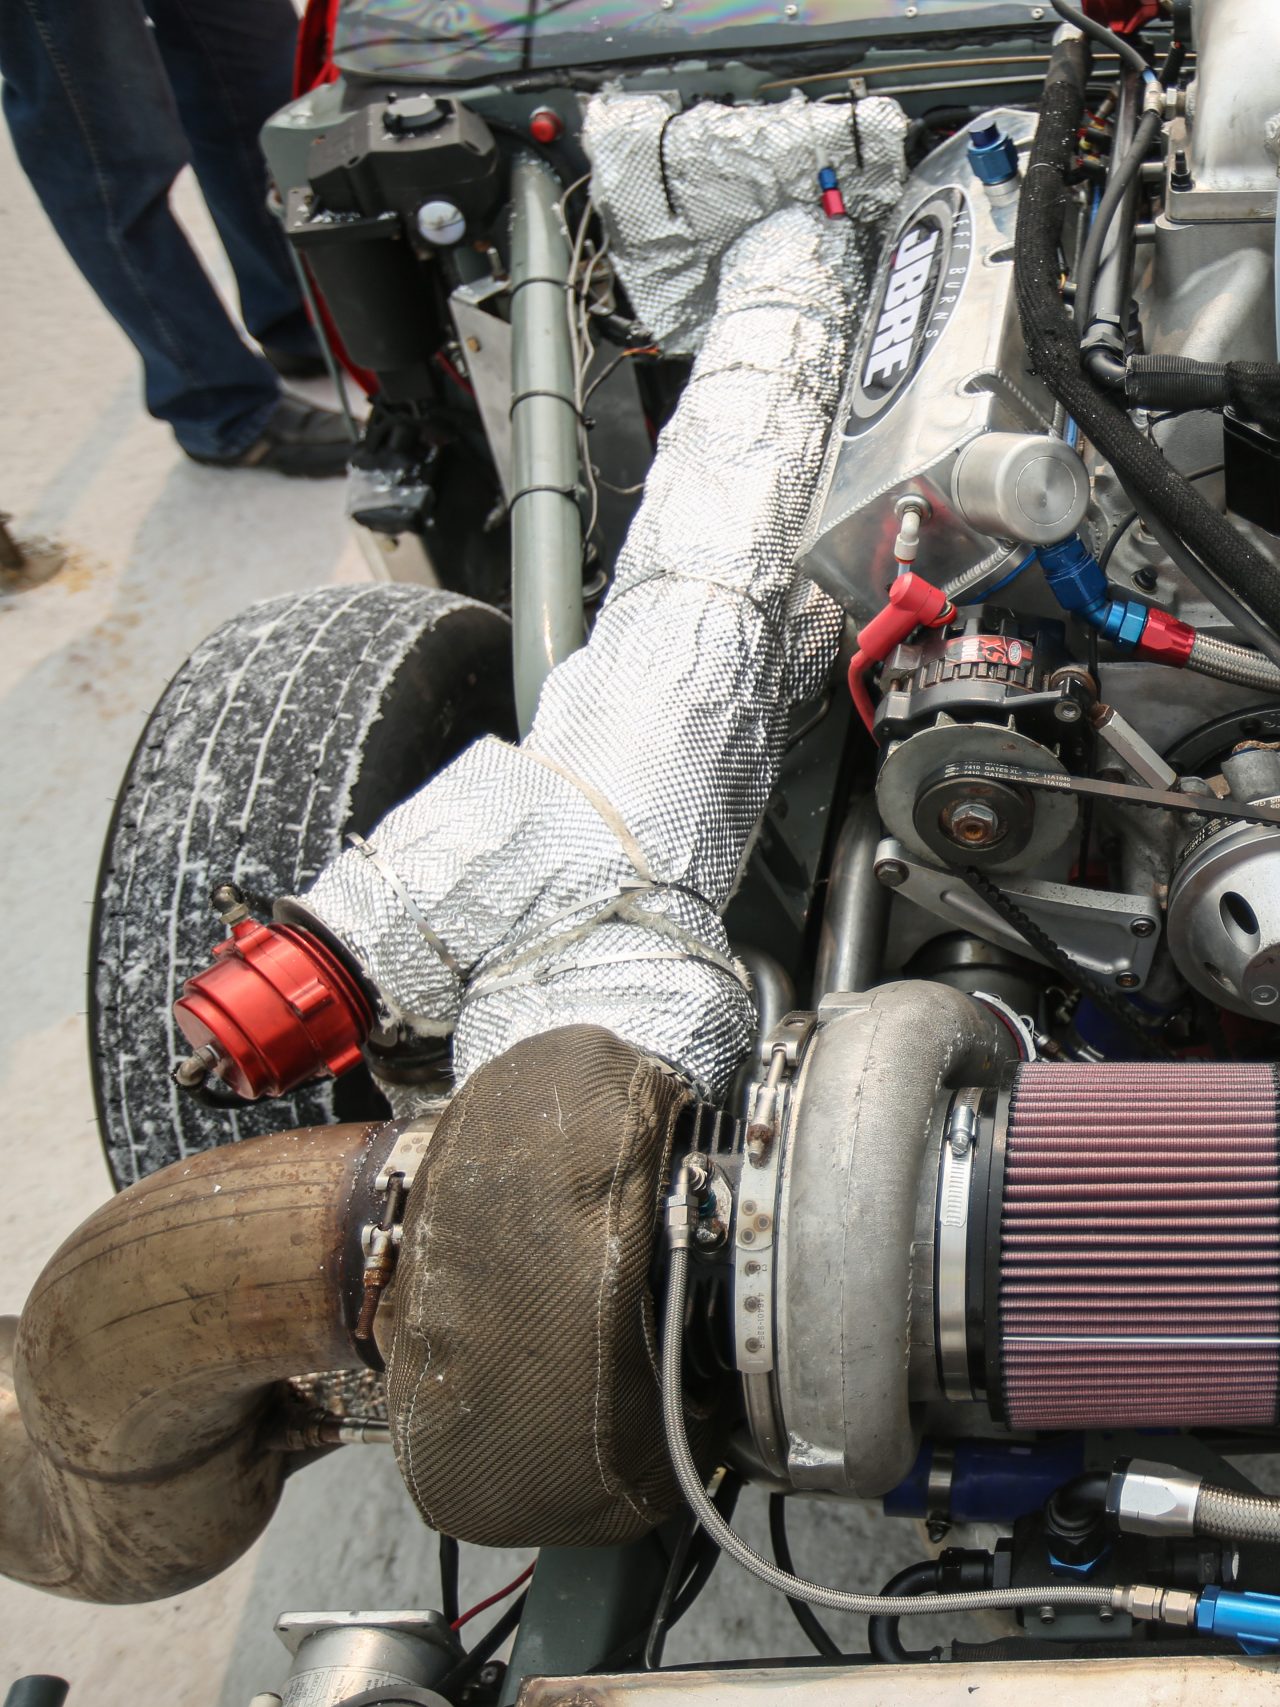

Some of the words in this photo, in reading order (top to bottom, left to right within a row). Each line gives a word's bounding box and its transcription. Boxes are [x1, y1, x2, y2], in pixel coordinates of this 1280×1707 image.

[952, 210, 970, 250] JEFF
[862, 229, 940, 389] JBRE
[925, 265, 967, 339] BURNS
[984, 765, 1009, 774] GATES
[1043, 773, 1071, 782] 11A1040
